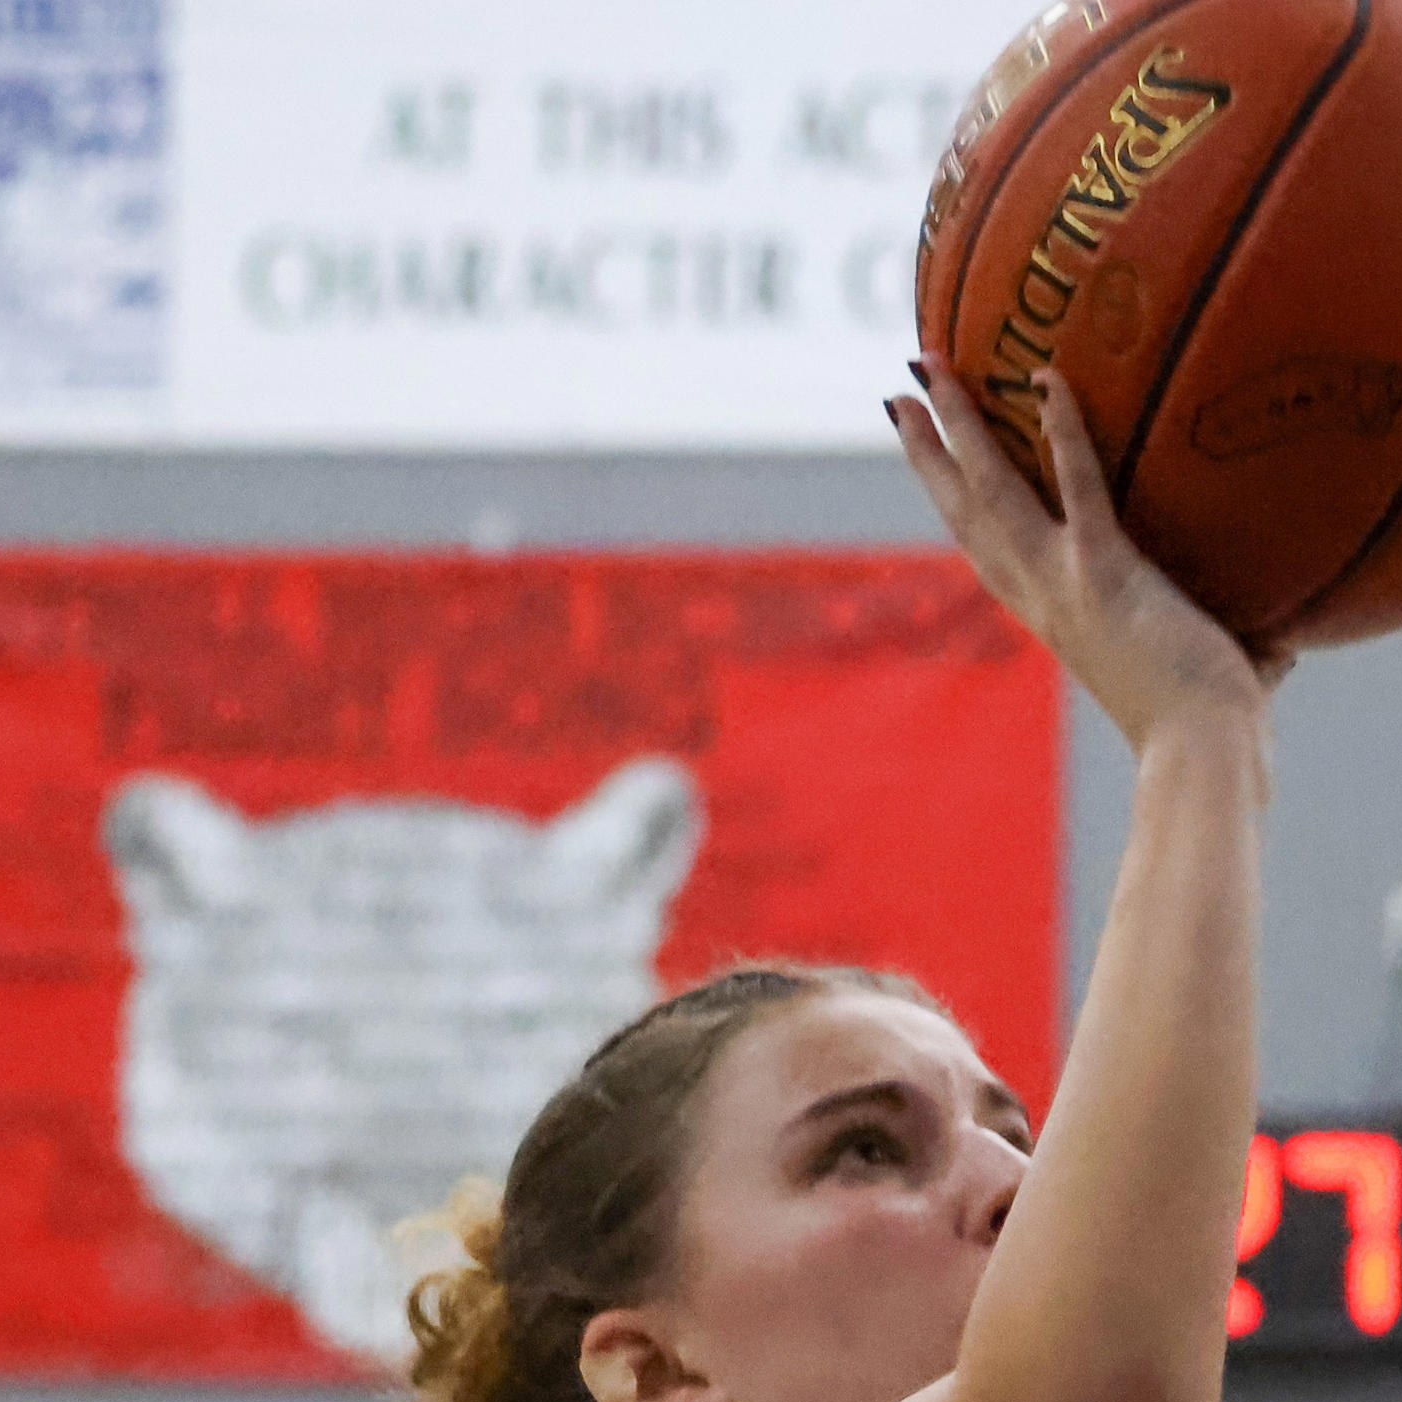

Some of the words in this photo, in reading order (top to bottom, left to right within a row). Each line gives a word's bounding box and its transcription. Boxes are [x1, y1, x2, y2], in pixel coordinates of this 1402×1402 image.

[364, 76, 478, 173] AT
[531, 74, 736, 177] THIS
[236, 216, 799, 332] CHARACTER
